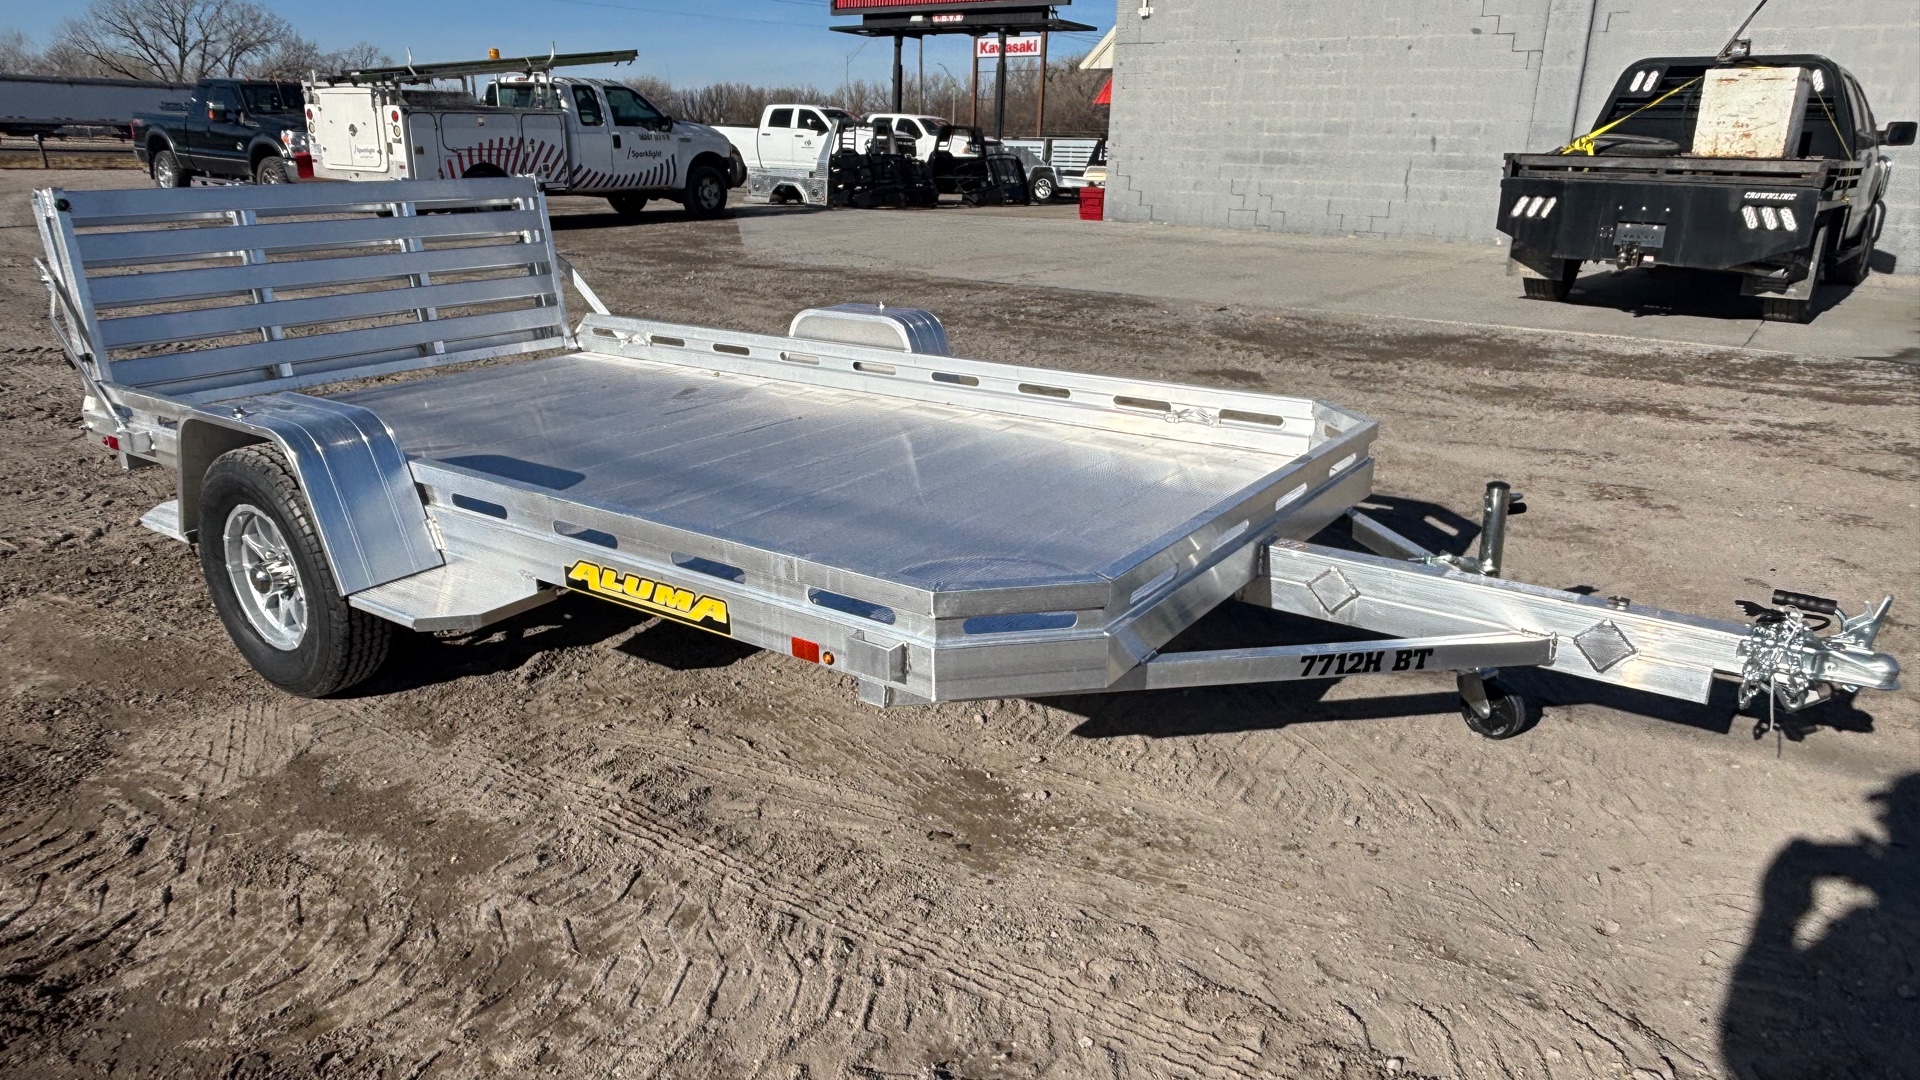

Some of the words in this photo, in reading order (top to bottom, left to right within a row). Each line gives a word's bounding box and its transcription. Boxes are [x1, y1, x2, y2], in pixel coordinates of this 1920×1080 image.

[631, 150, 662, 159] Sparklight
[1743, 191, 1798, 201] CROWNLINE
[567, 560, 729, 625] ALUMA
[1300, 650, 1386, 677] 7712H
[1391, 648, 1434, 671] BT
